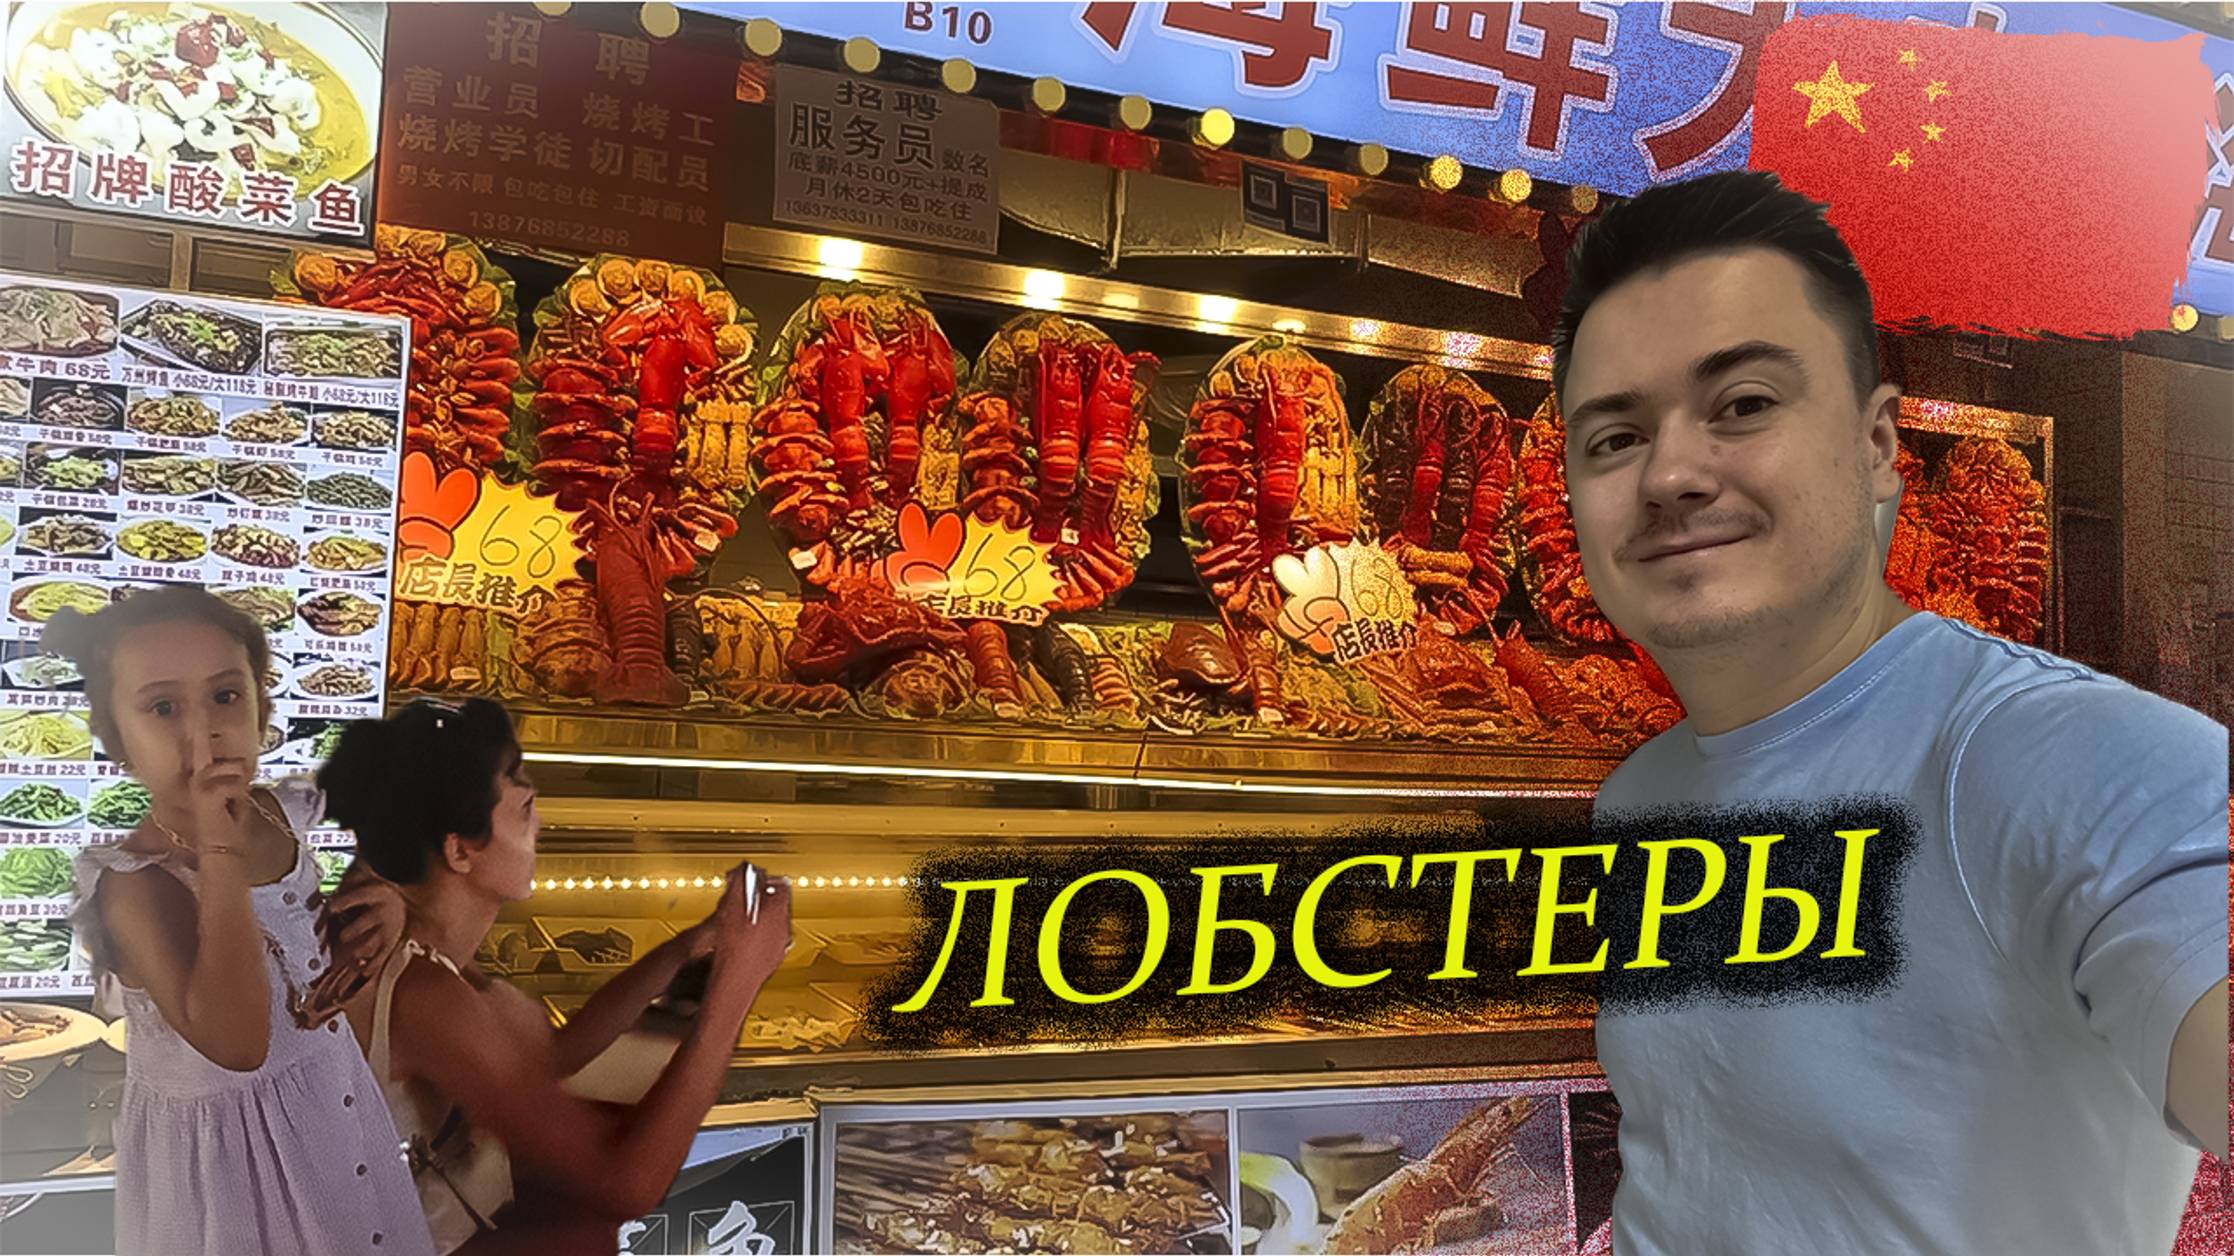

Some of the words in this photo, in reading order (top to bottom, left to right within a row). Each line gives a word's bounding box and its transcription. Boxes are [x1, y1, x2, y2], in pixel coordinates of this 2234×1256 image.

[904, 1, 992, 44] B10
[403, 65, 539, 119] 营业员
[582, 93, 715, 147] 烧烤工
[835, 79, 943, 122] 招聘
[397, 113, 573, 171] 烧烤学徒
[589, 137, 711, 192] 切配员
[790, 103, 934, 169] 服务员
[14, 140, 362, 234] 招牌酸菜鱼
[503, 177, 600, 209] 包吃包住
[805, 177, 973, 223] 月休2天包吃住
[479, 503, 563, 580] 68
[963, 532, 1037, 602] 68
[1350, 555, 1404, 621] 68
